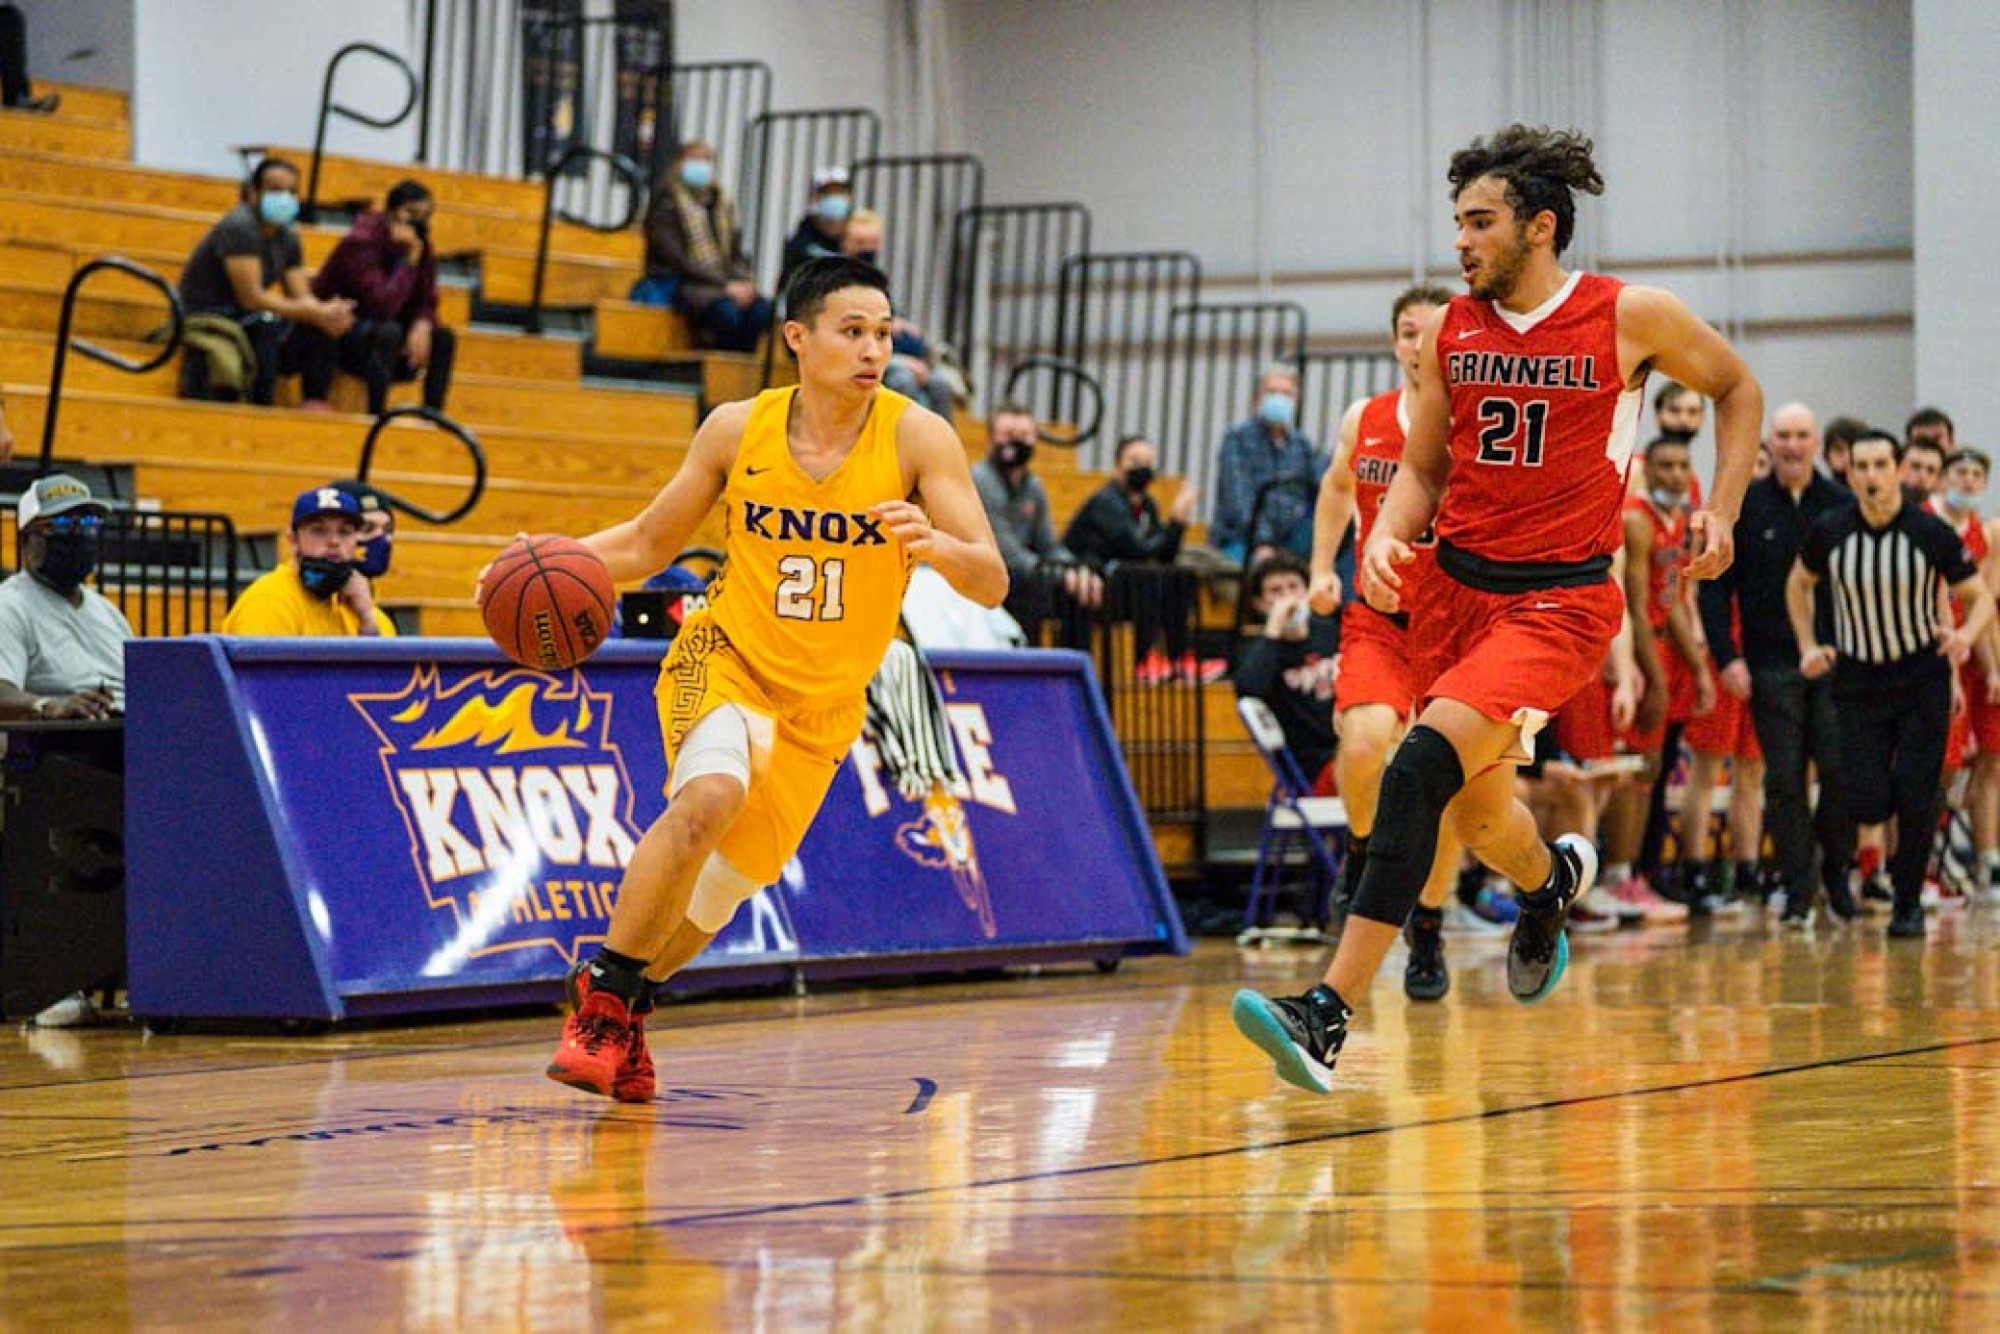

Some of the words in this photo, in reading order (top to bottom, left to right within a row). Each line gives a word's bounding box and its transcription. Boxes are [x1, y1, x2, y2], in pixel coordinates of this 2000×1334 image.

[1447, 351, 1600, 390] GRINNELL
[1475, 396, 1549, 467] 21
[317, 487, 342, 509] K
[744, 500, 887, 546] KNOX
[775, 554, 844, 621] 21
[398, 764, 637, 883] KNOX
